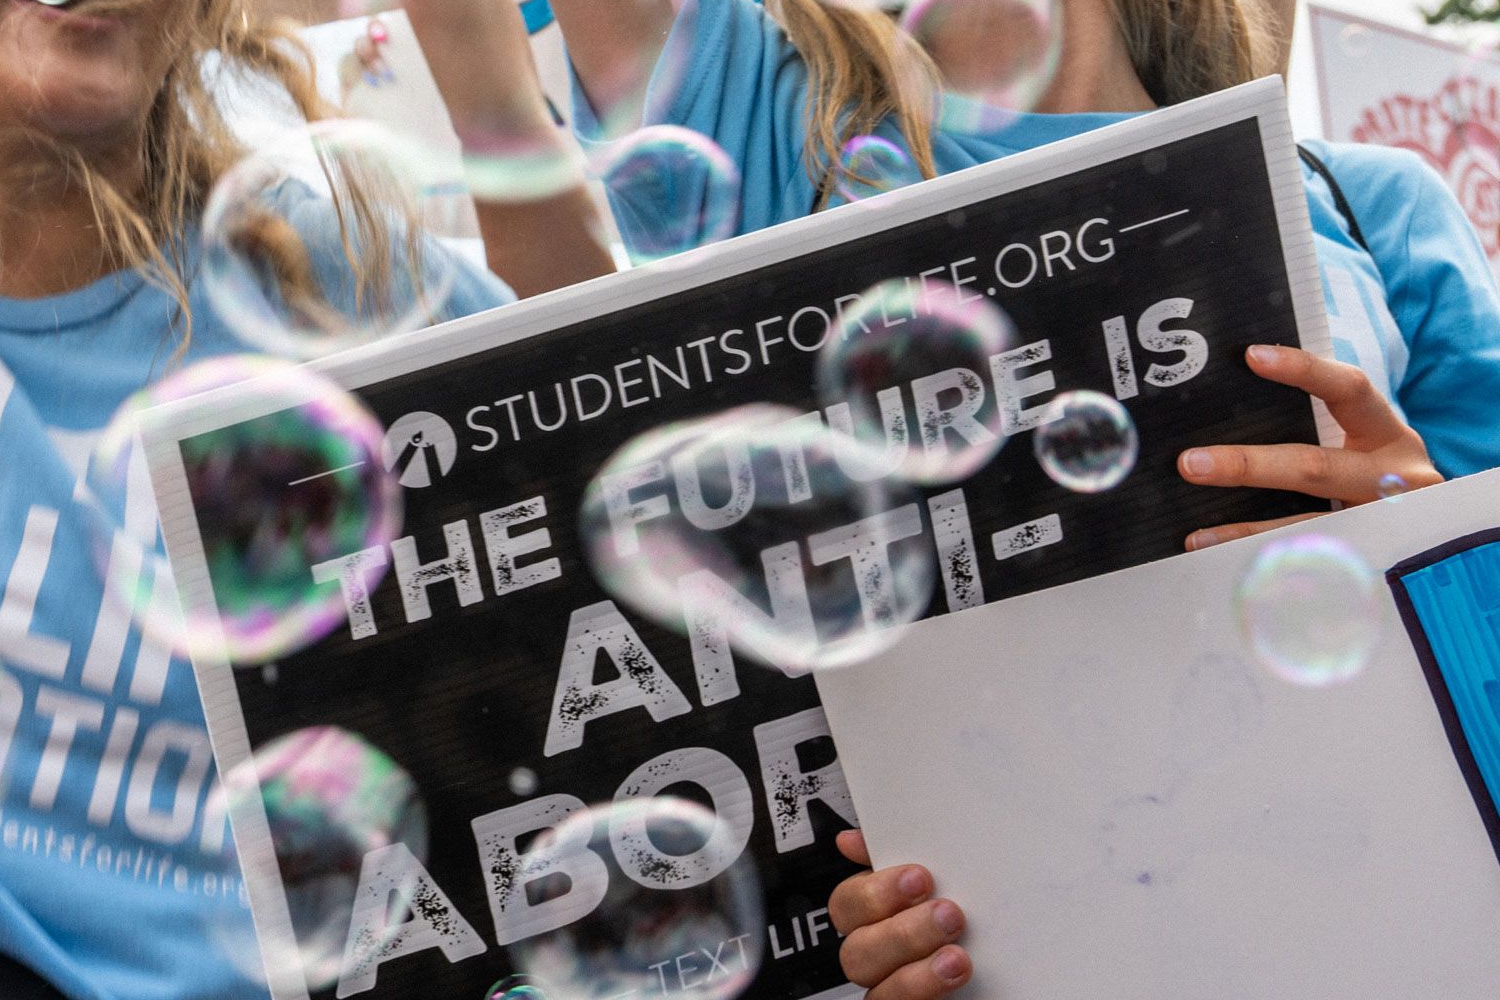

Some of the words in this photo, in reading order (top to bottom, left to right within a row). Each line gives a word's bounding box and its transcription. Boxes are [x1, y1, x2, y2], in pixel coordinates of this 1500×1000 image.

[466, 217, 1118, 454] STUDENTSFORLIFE.ORG
[312, 495, 563, 642] THE
[602, 338, 1060, 560] FUTURE
[1103, 297, 1210, 400] IS
[543, 488, 1063, 759] ANTI-
[648, 932, 752, 998] TEXT
[768, 906, 845, 961] LIF
